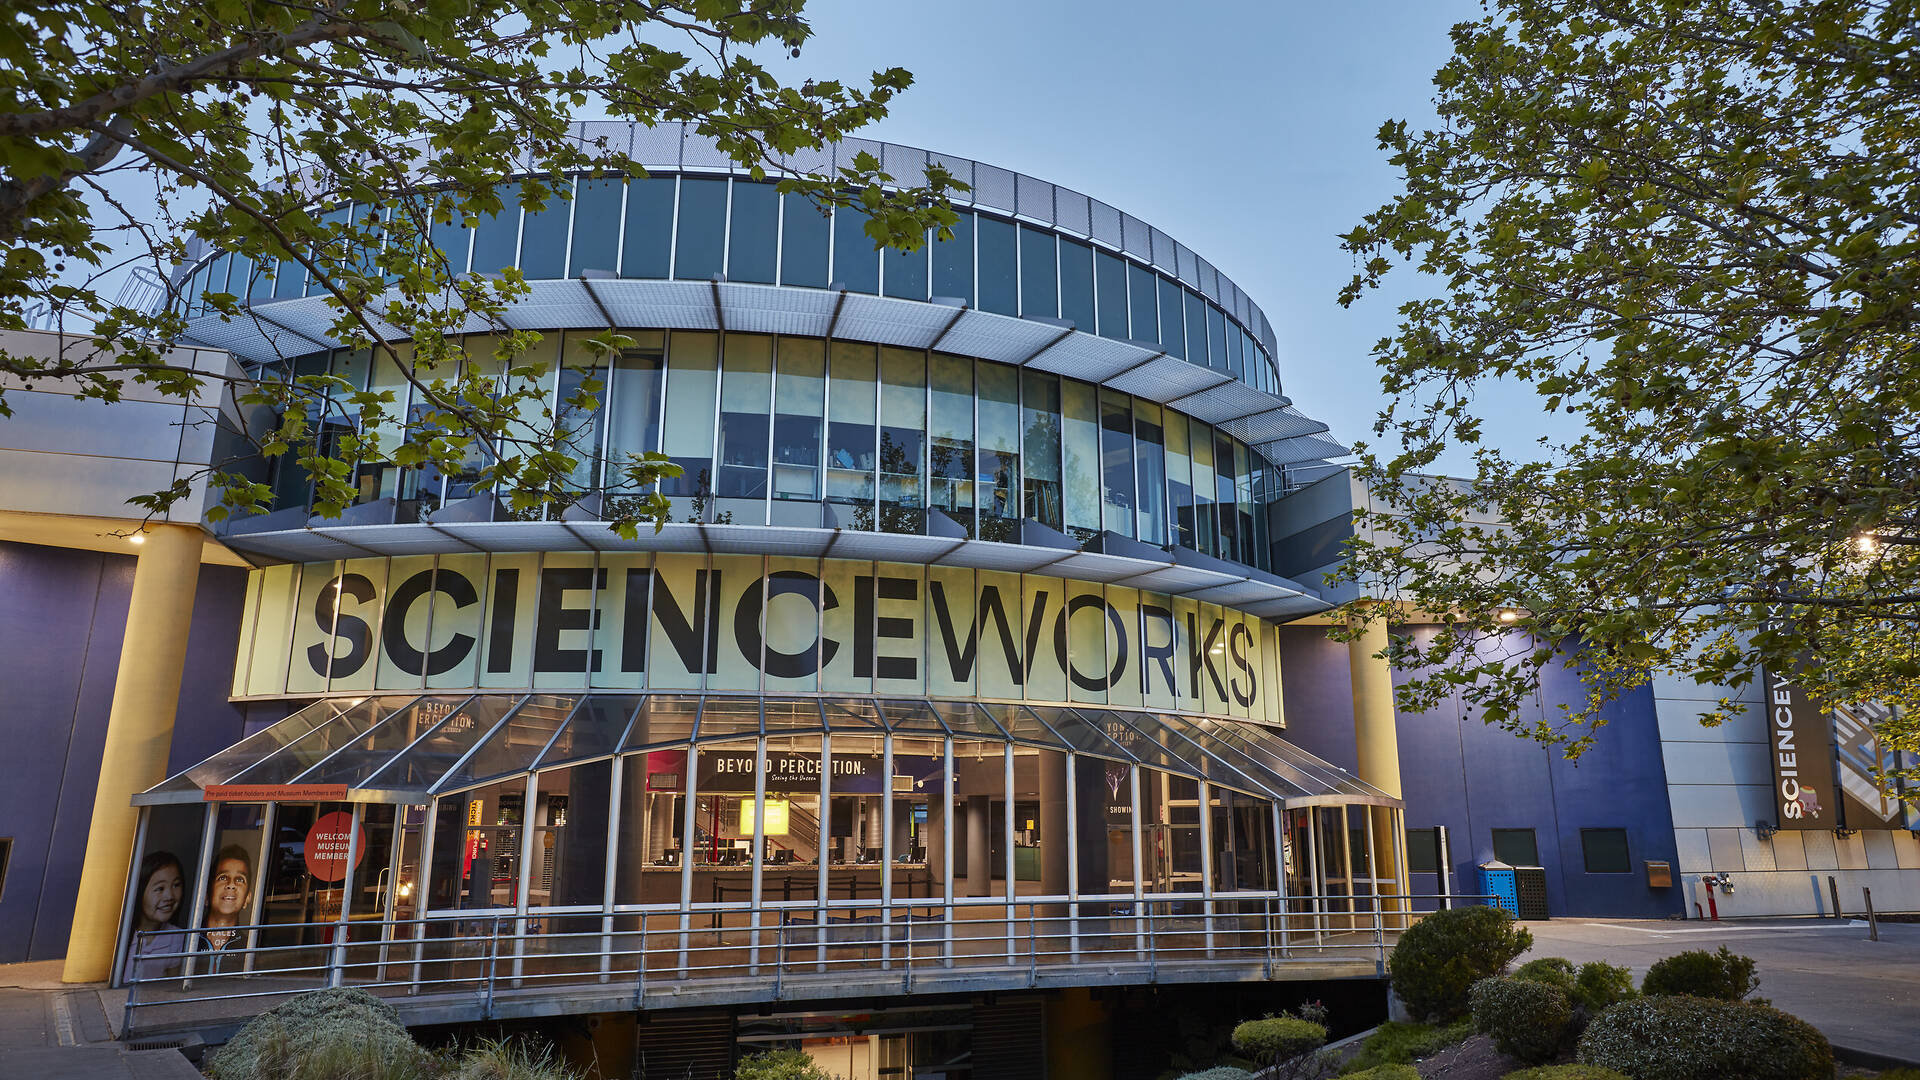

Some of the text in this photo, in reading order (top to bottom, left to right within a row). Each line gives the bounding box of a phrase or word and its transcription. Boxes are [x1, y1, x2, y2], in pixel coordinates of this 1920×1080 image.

[307, 567, 1257, 708] SCIENCEWORKS
[717, 758, 866, 775] BEYOD PERCETION:
[316, 833, 351, 841] WELCOM
[314, 852, 349, 860] MEMBER
